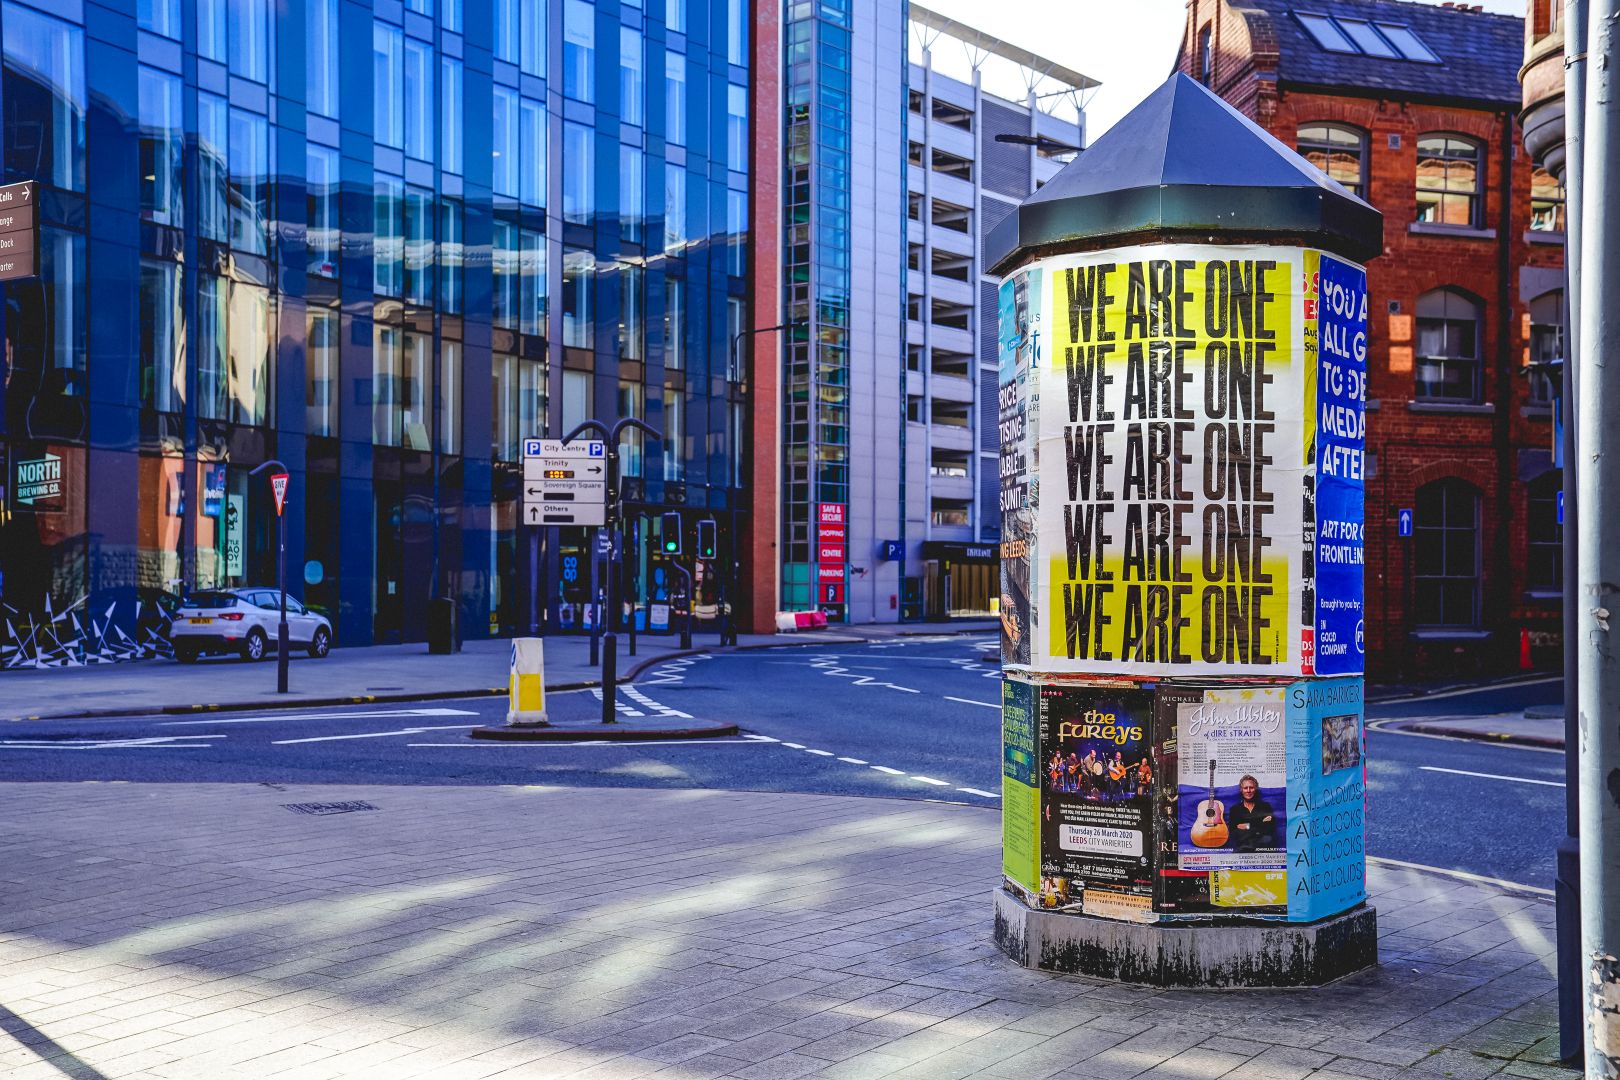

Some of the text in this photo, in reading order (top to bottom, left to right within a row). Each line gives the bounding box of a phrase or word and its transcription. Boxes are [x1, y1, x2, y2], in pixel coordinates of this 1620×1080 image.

[1065, 263, 1116, 343] WE
[1124, 260, 1195, 339] ARE
[1204, 260, 1276, 339] ONE
[1324, 279, 1355, 319] YOU
[1324, 321, 1350, 358] ALL
[1064, 344, 1115, 422] WE
[1123, 342, 1195, 420] ARE
[1204, 342, 1276, 420] ONE
[1323, 361, 1343, 396] TO
[999, 384, 1016, 410] RICE
[544, 444, 558, 452] City
[18, 461, 61, 483] NORTH
[1063, 422, 1275, 501] WE ARE ONE
[18, 485, 48, 497] BREWING
[274, 480, 285, 489] GIVE
[822, 505, 836, 513] SAFE
[1005, 486, 1022, 511] UNIT
[822, 514, 842, 522] SECURE
[1320, 519, 1358, 541] ART FOR
[822, 549, 842, 557] CENTRE
[1009, 540, 1026, 558] LEEDS
[1063, 503, 1274, 583] WE ARE ONE
[1320, 544, 1365, 564] FRONTLIN
[819, 569, 844, 577] PARKING
[1320, 599, 1338, 610] Brought
[1063, 583, 1113, 660] WE
[1121, 584, 1192, 664] ARE
[1201, 585, 1273, 664] ONE
[1320, 632, 1336, 642] GOOD
[1320, 643, 1348, 656] COMPANY
[1293, 685, 1360, 708] SARA BARKER
[1084, 710, 1116, 724] the
[1189, 706, 1280, 736] John Illsley
[1204, 730, 1210, 740] of
[1294, 782, 1362, 812] ALL CLOUDS
[1068, 826, 1092, 837] Thursday
[1102, 830, 1118, 838] March
[1294, 808, 1362, 839] ARE CLOCKS
[1070, 836, 1088, 844] LEEDS
[1089, 838, 1100, 846] CITY
[1295, 835, 1362, 868] ALL CLOCKS
[1296, 874, 1320, 896] ARE
[1323, 862, 1362, 890] CLOUDS
